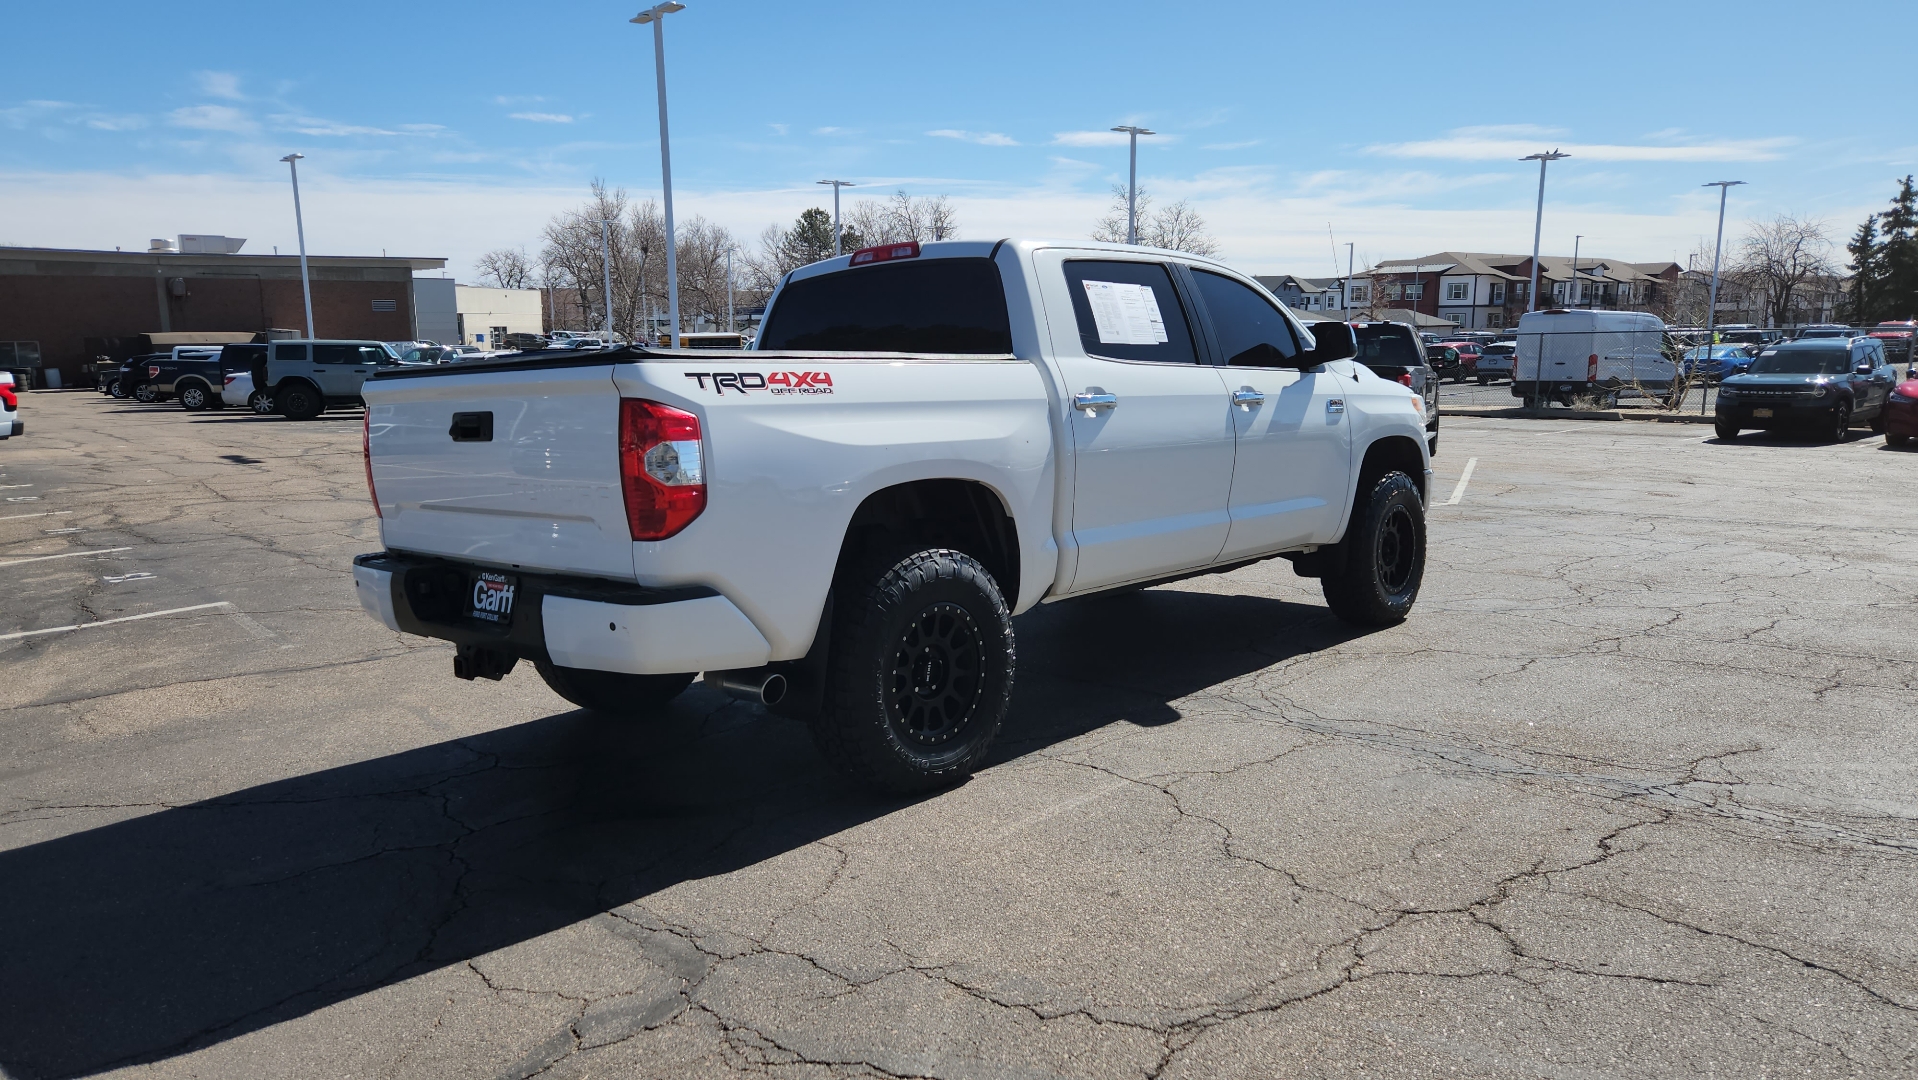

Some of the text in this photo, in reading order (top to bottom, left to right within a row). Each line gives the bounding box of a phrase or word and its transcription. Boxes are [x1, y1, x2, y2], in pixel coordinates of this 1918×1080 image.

[684, 372, 833, 396] TRD 4X4
[474, 580, 514, 613] Garff
